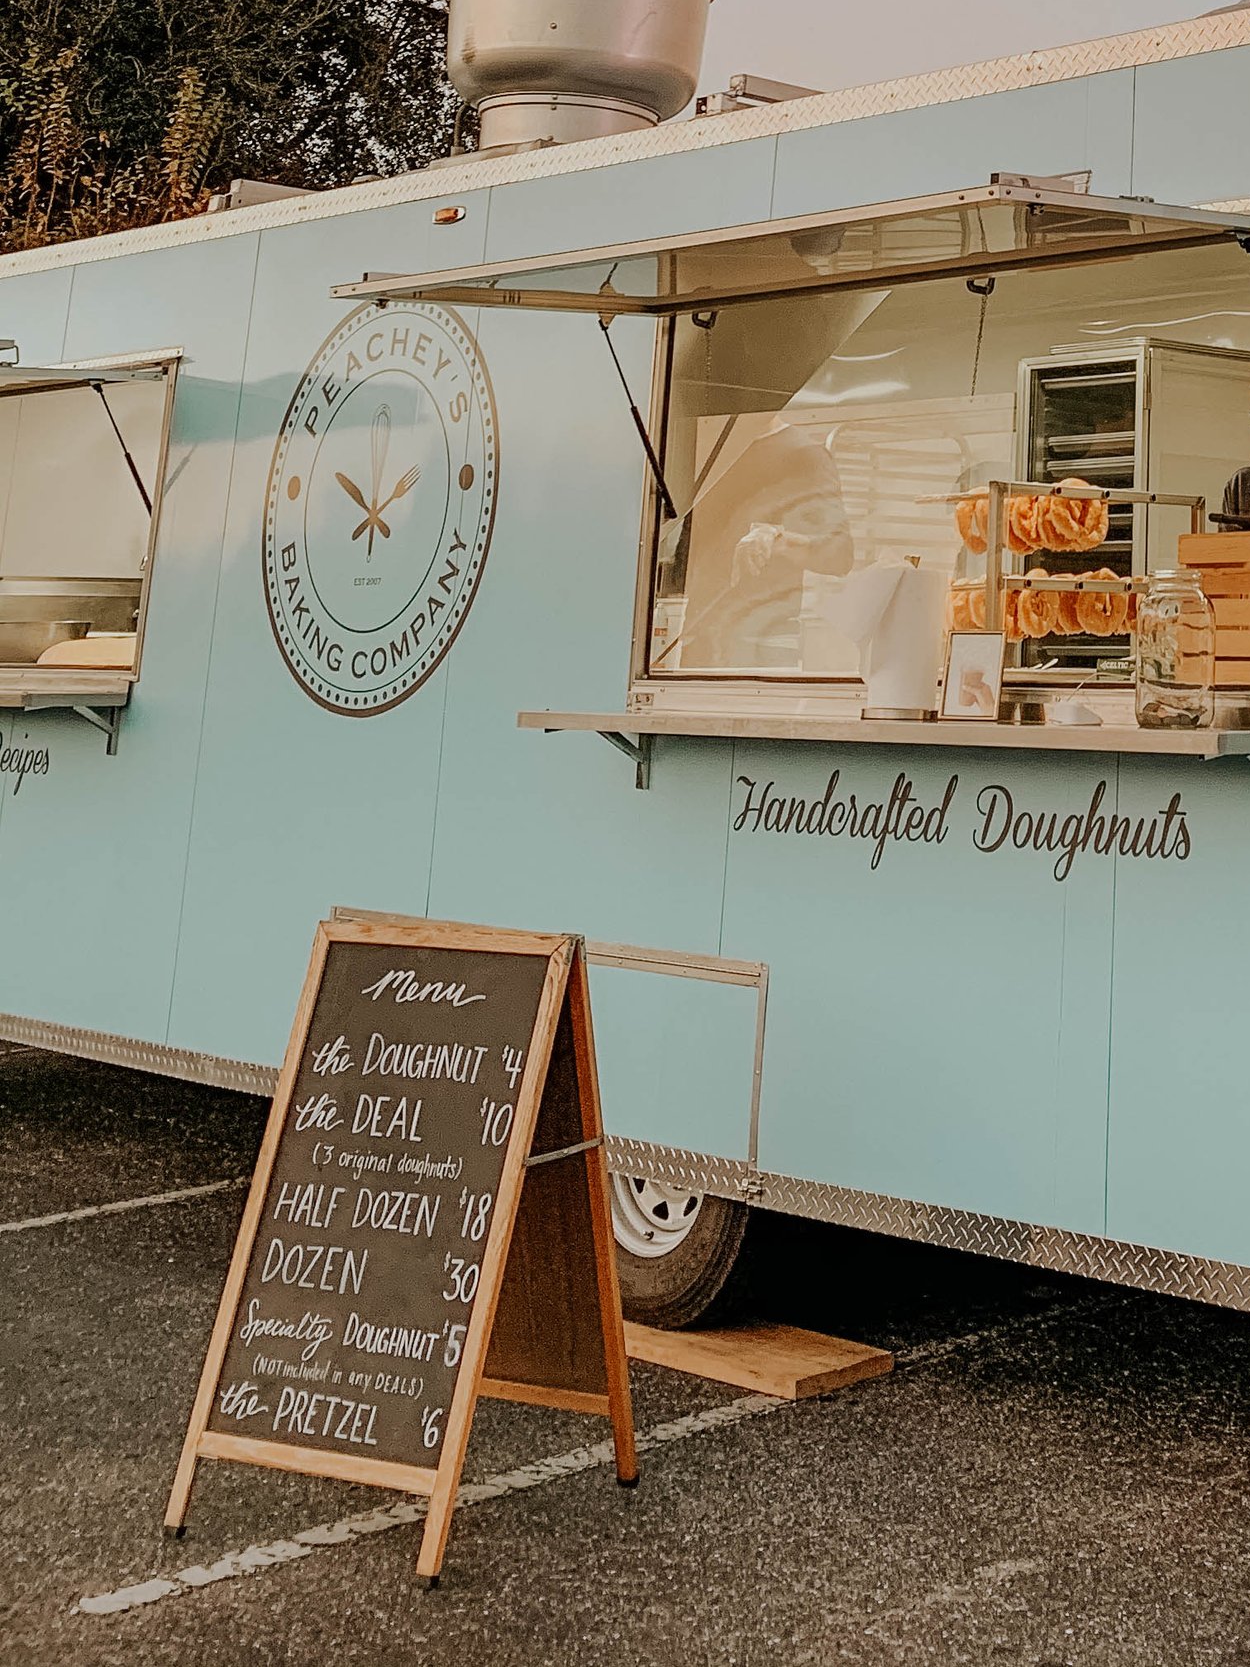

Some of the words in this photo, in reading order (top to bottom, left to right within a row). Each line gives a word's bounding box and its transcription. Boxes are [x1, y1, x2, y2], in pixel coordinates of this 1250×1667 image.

[304, 327, 468, 438] PEACHEY'S
[280, 540, 344, 674] BAKING
[350, 527, 468, 679] COMPANY
[0, 731, 50, 796] ecipes
[733, 769, 959, 870] Handcrafted
[973, 780, 1192, 882] Doughnuts
[361, 969, 487, 1007] Menu
[312, 1035, 355, 1076] the
[362, 1033, 489, 1084] DOUGHNUT
[502, 1044, 523, 1089] $4
[296, 1093, 345, 1131] the
[351, 1094, 423, 1142] DEAL
[480, 1096, 514, 1146] $10
[338, 1150, 391, 1181] original
[397, 1153, 463, 1184] doughnuts)
[273, 1182, 347, 1228] HALF
[351, 1188, 441, 1238] DOZEN
[459, 1186, 492, 1241] $18
[261, 1238, 368, 1295] DOZEN
[442, 1251, 480, 1303] $30
[240, 1298, 333, 1361] Specialty
[342, 1312, 440, 1361] DOUGHNUT
[442, 1319, 468, 1368] $5
[220, 1381, 269, 1420] the
[272, 1386, 378, 1445] PRETZEL
[421, 1406, 444, 1448] $6
[331, 1368, 343, 1384] in
[348, 1371, 372, 1393] any
[375, 1375, 425, 1400] DEALS)
